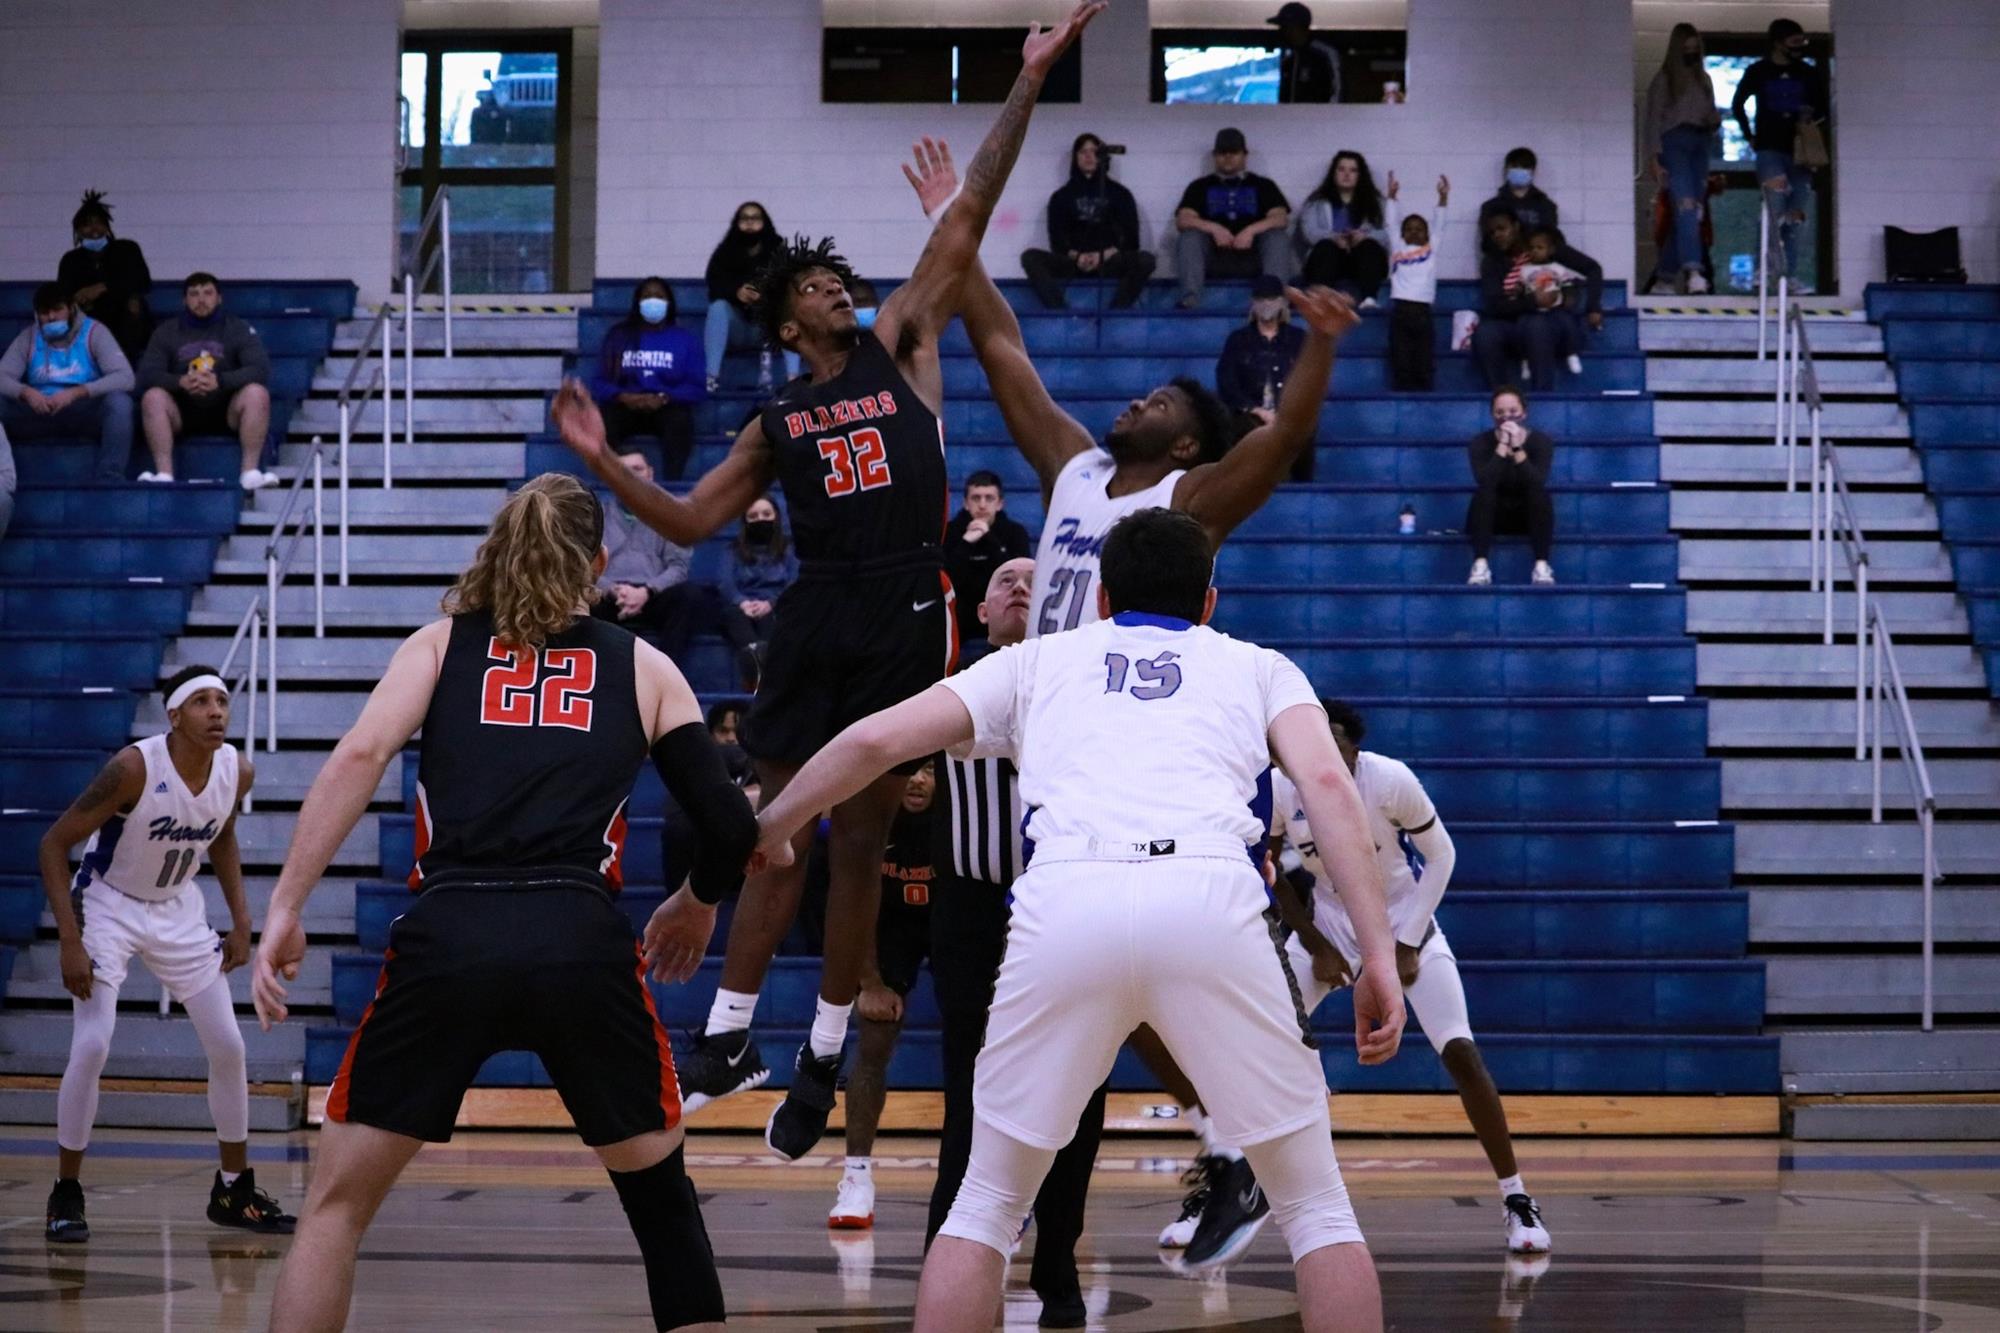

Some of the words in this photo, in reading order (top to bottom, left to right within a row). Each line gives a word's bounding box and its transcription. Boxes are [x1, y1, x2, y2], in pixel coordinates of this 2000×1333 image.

[784, 390, 898, 439] BLAZERS
[816, 427, 892, 498] 32
[1037, 567, 1092, 635] 21
[480, 635, 597, 732] 22
[1104, 650, 1182, 700] 15
[155, 848, 195, 888] 11
